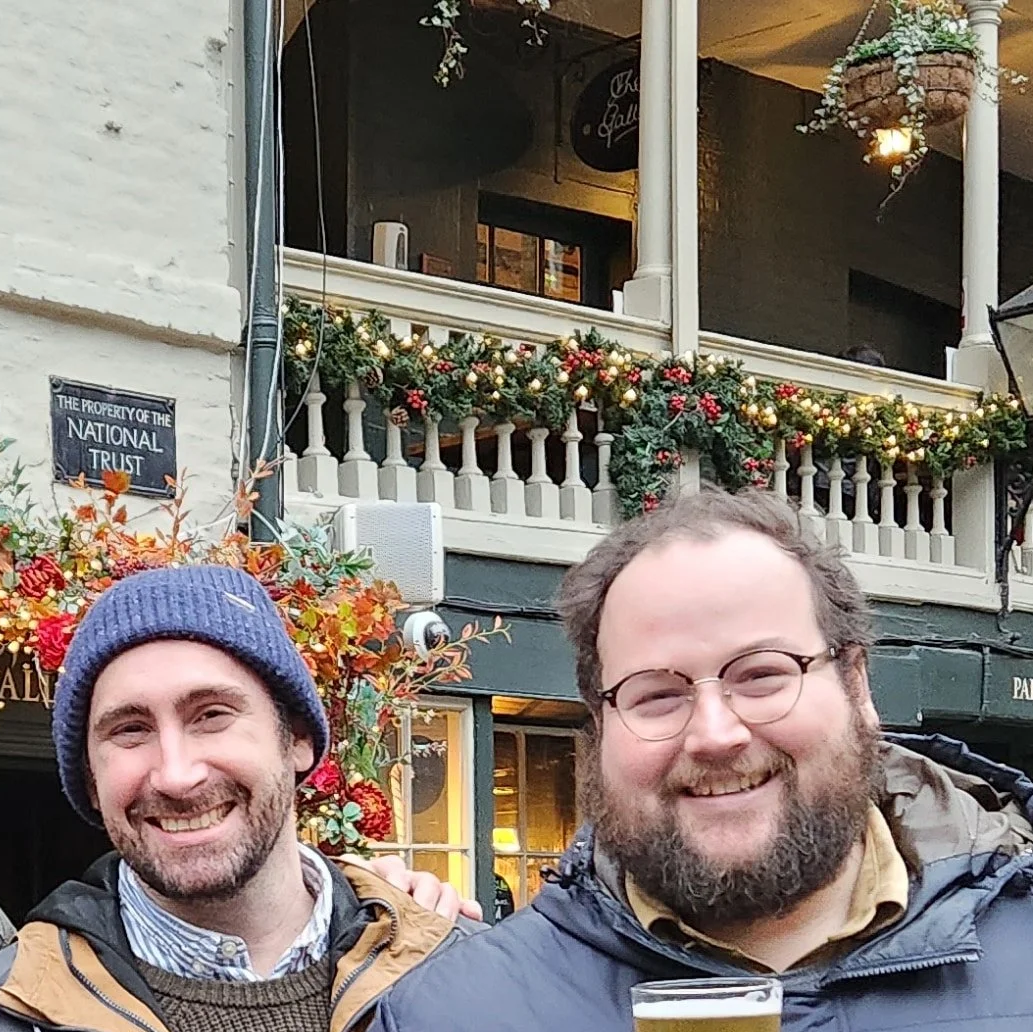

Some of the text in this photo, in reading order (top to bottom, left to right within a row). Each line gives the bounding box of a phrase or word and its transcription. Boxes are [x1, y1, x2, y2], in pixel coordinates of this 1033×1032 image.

[598, 99, 640, 149] Gall
[56, 394, 172, 428] THE PROPERTY OF THE
[67, 416, 164, 454] NATIONAL
[88, 448, 145, 477] TRUST
